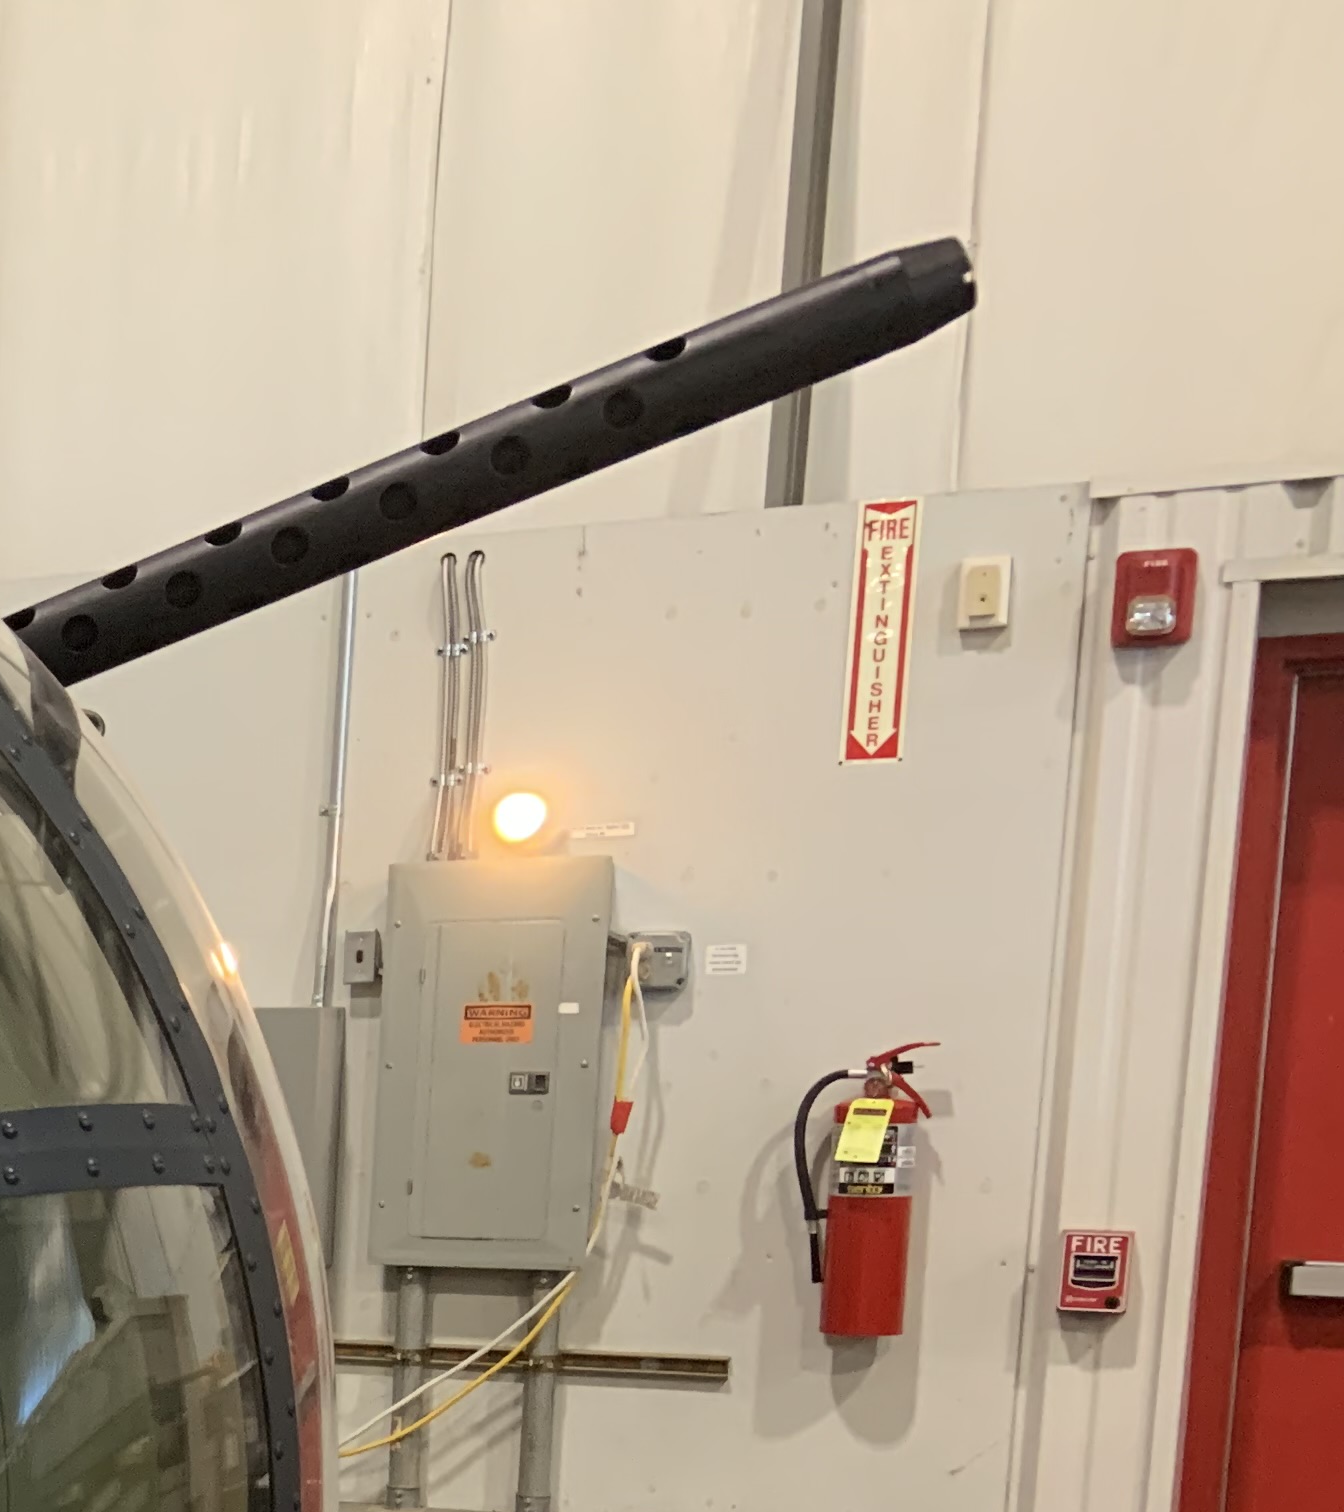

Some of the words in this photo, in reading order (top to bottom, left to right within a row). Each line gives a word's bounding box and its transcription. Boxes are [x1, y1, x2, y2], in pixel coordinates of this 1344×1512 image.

[868, 517, 909, 541] FIRE
[866, 546, 893, 747] EXTINGUISHER
[468, 1009, 527, 1018] WARNING
[1071, 1236, 1123, 1253] FIRE
